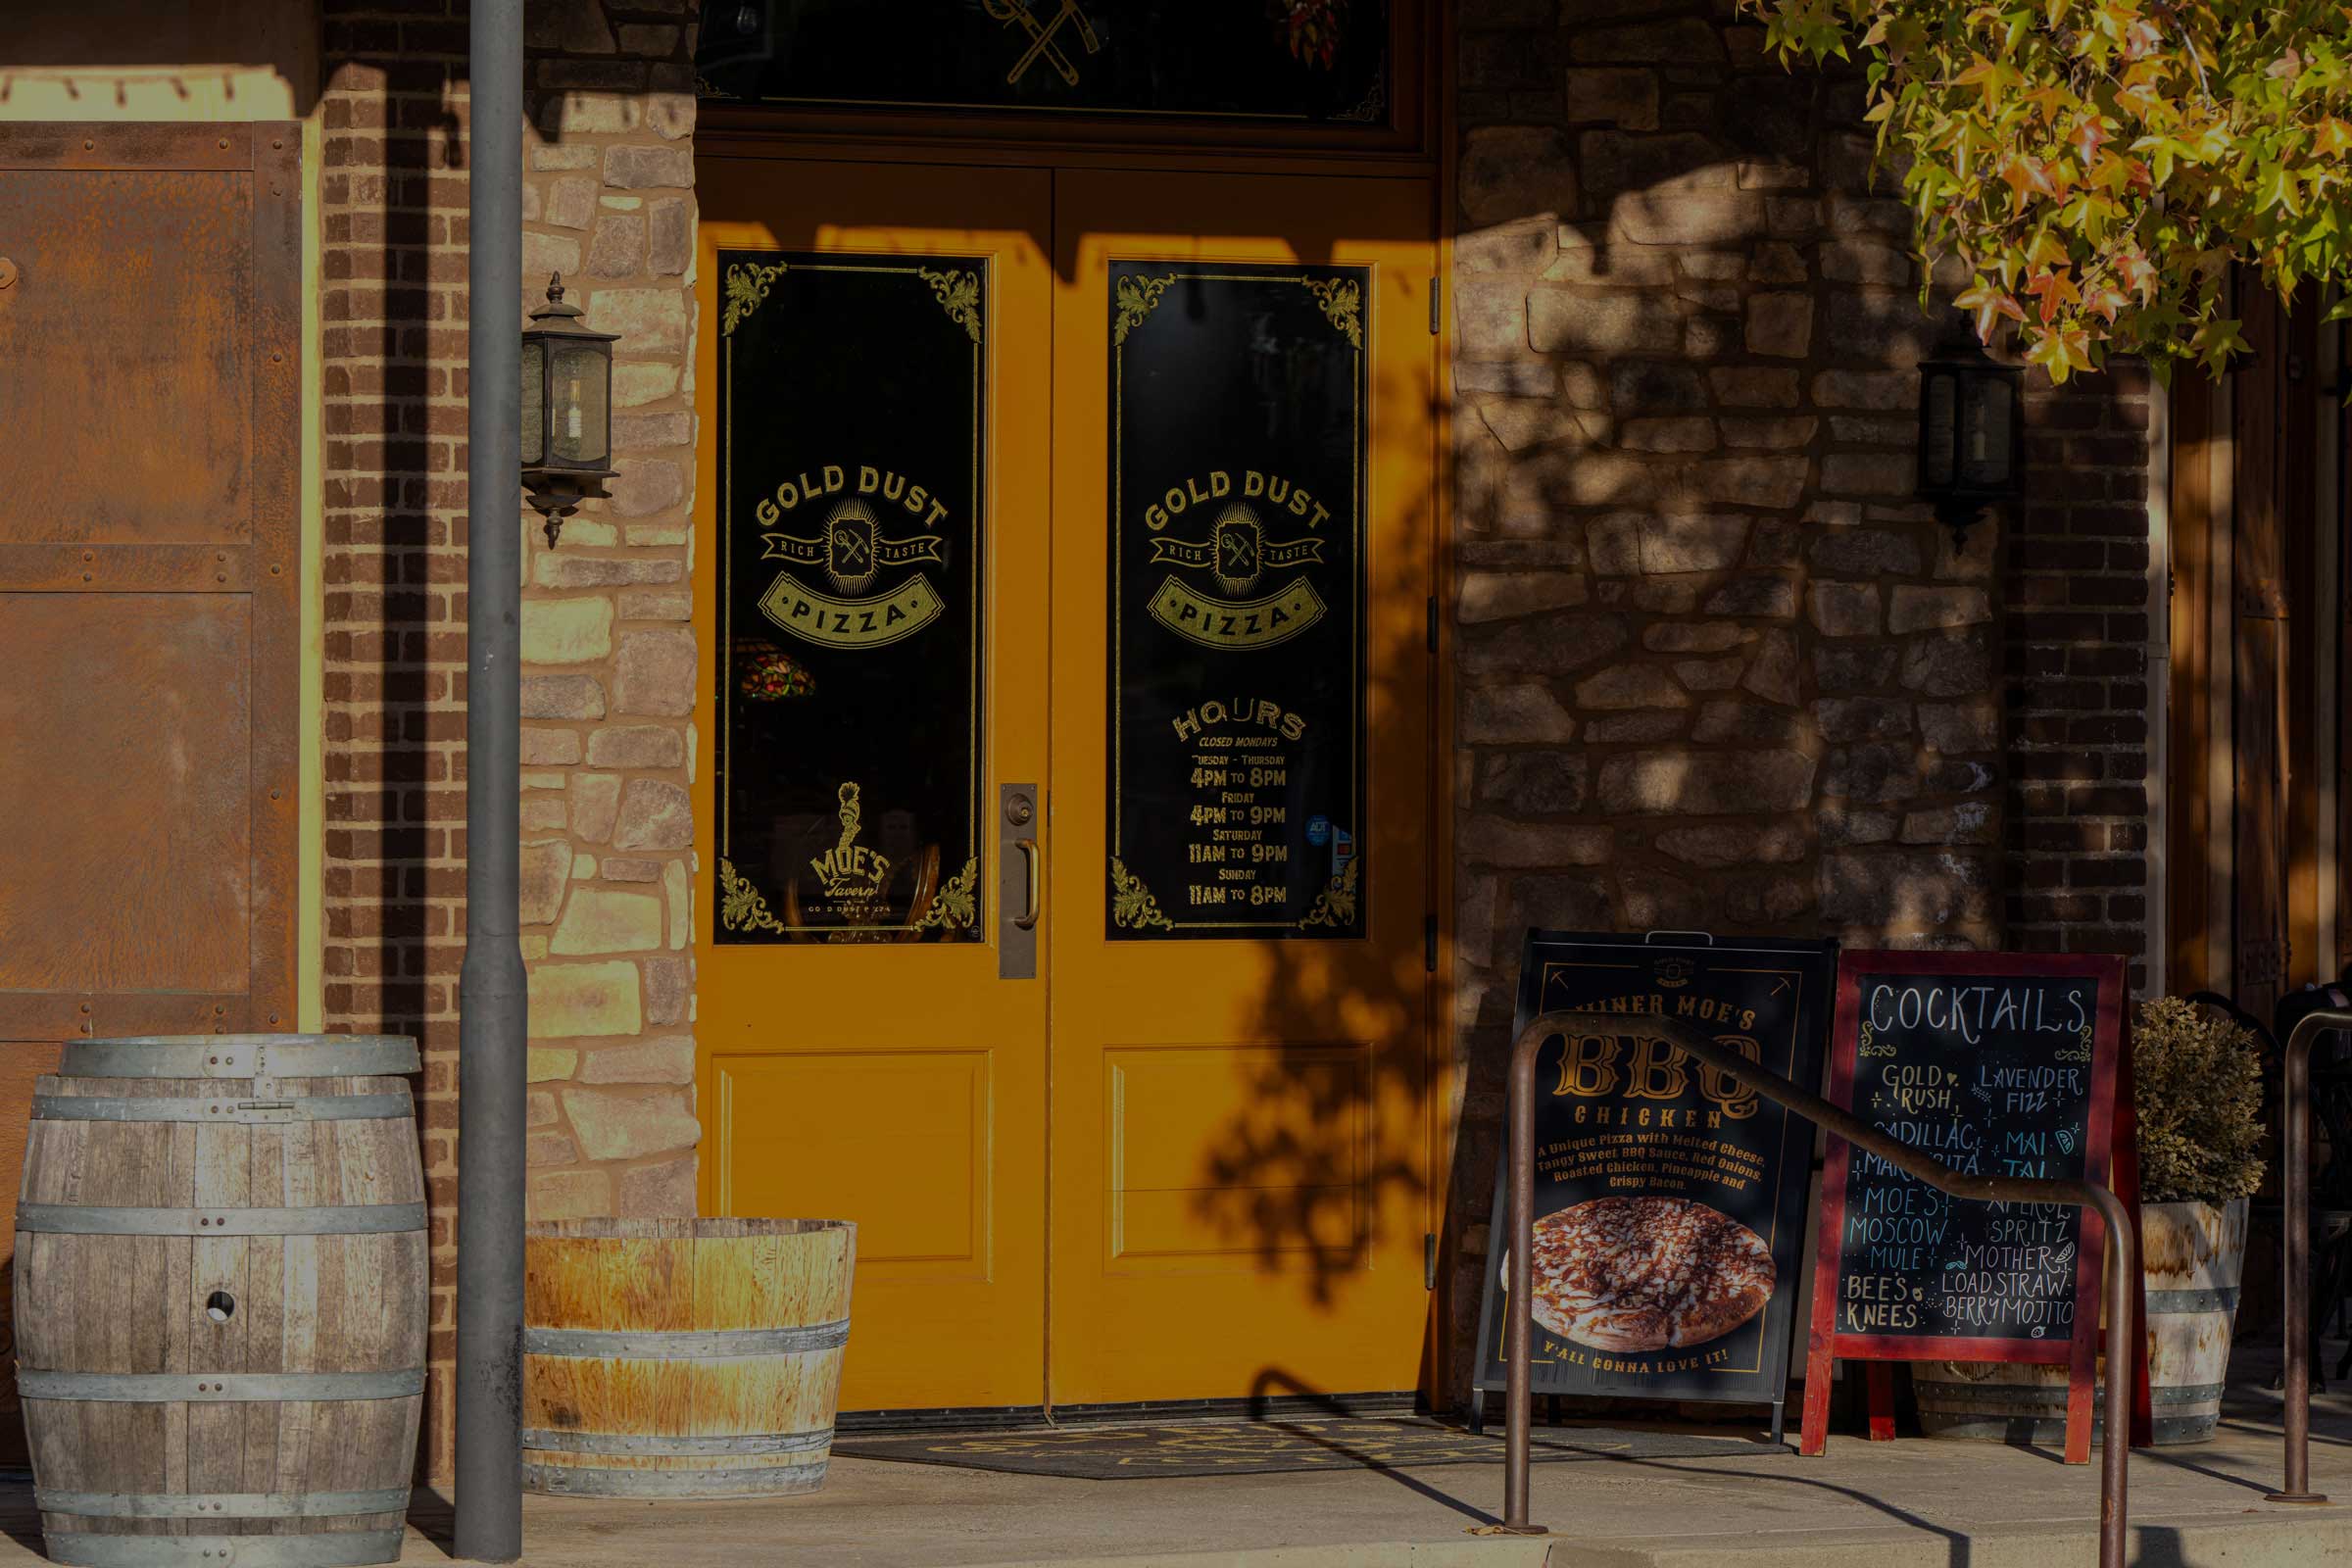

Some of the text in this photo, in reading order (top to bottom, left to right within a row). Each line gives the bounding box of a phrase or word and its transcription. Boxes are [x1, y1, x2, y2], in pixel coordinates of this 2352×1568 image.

[756, 465, 949, 528] GOLD DUST
[1145, 469, 1332, 531] GOLD DUST
[781, 540, 925, 559] RICH TASTE
[1169, 545, 1308, 561] RICH TASTE
[792, 600, 906, 633] PIZZA
[1179, 604, 1290, 635] PIZZA
[1172, 697, 1306, 742] HOURS
[1199, 737, 1279, 747] CLOSED MONDAYS
[1192, 755, 1229, 764] TUESDAY
[1241, 755, 1286, 765] THURSDAY
[1191, 767, 1286, 788] 4PM TO 8PM
[1222, 791, 1254, 804] FRIDAY
[1191, 805, 1286, 826] 4PM TO 9PM
[1212, 829, 1262, 841] SATURDAY
[1189, 843, 1288, 862] 11AM TO 9PM
[809, 846, 891, 885] MOE'S
[1218, 868, 1256, 880] SUNDAY
[824, 878, 875, 898] Tavern
[1189, 885, 1287, 906] 11AM TO 8PM
[1677, 994, 1757, 1031] MOE'S
[1870, 984, 2086, 1045] COCKTAILS
[1552, 1034, 1763, 1120] BBQ
[1882, 1064, 1942, 1100] GOLD
[1981, 1065, 2084, 1097] LAVENDER
[1901, 1089, 1952, 1114] RUSH
[2006, 1092, 2048, 1114] FIZZ
[1574, 1105, 1722, 1129] CHICKEN
[1537, 1145, 1547, 1157] A
[1548, 1137, 1595, 1154] Unique
[1599, 1133, 1634, 1145] Pizza
[1637, 1132, 1669, 1144] with
[1672, 1133, 1718, 1152] Melted
[2006, 1130, 2046, 1155] MAI
[1537, 1154, 1574, 1173] Tangy
[1578, 1147, 1617, 1162] Sweet
[1622, 1147, 1645, 1160] BBQ
[1692, 1152, 1717, 1166] Red
[2002, 1159, 2046, 1179] TAI
[1552, 1163, 1603, 1183] Roasted
[1661, 1162, 1721, 1183] Pineapple
[1721, 1175, 1747, 1191] and
[1609, 1176, 1647, 1189] Crispy
[1865, 1185, 1938, 1216] MOE'S
[1849, 1216, 1948, 1247] MOSCOW
[1989, 1219, 2070, 1248] SPRITZ
[1870, 1246, 1924, 1270] MULE
[1965, 1245, 2060, 1274] MOTHER
[1941, 1272, 1992, 1294] LOAD
[1847, 1301, 1918, 1333] KNEES
[2001, 1298, 2075, 1325] MOJITO
[1544, 1341, 1730, 1373] Y'ALL GONNA LOVE IT!
